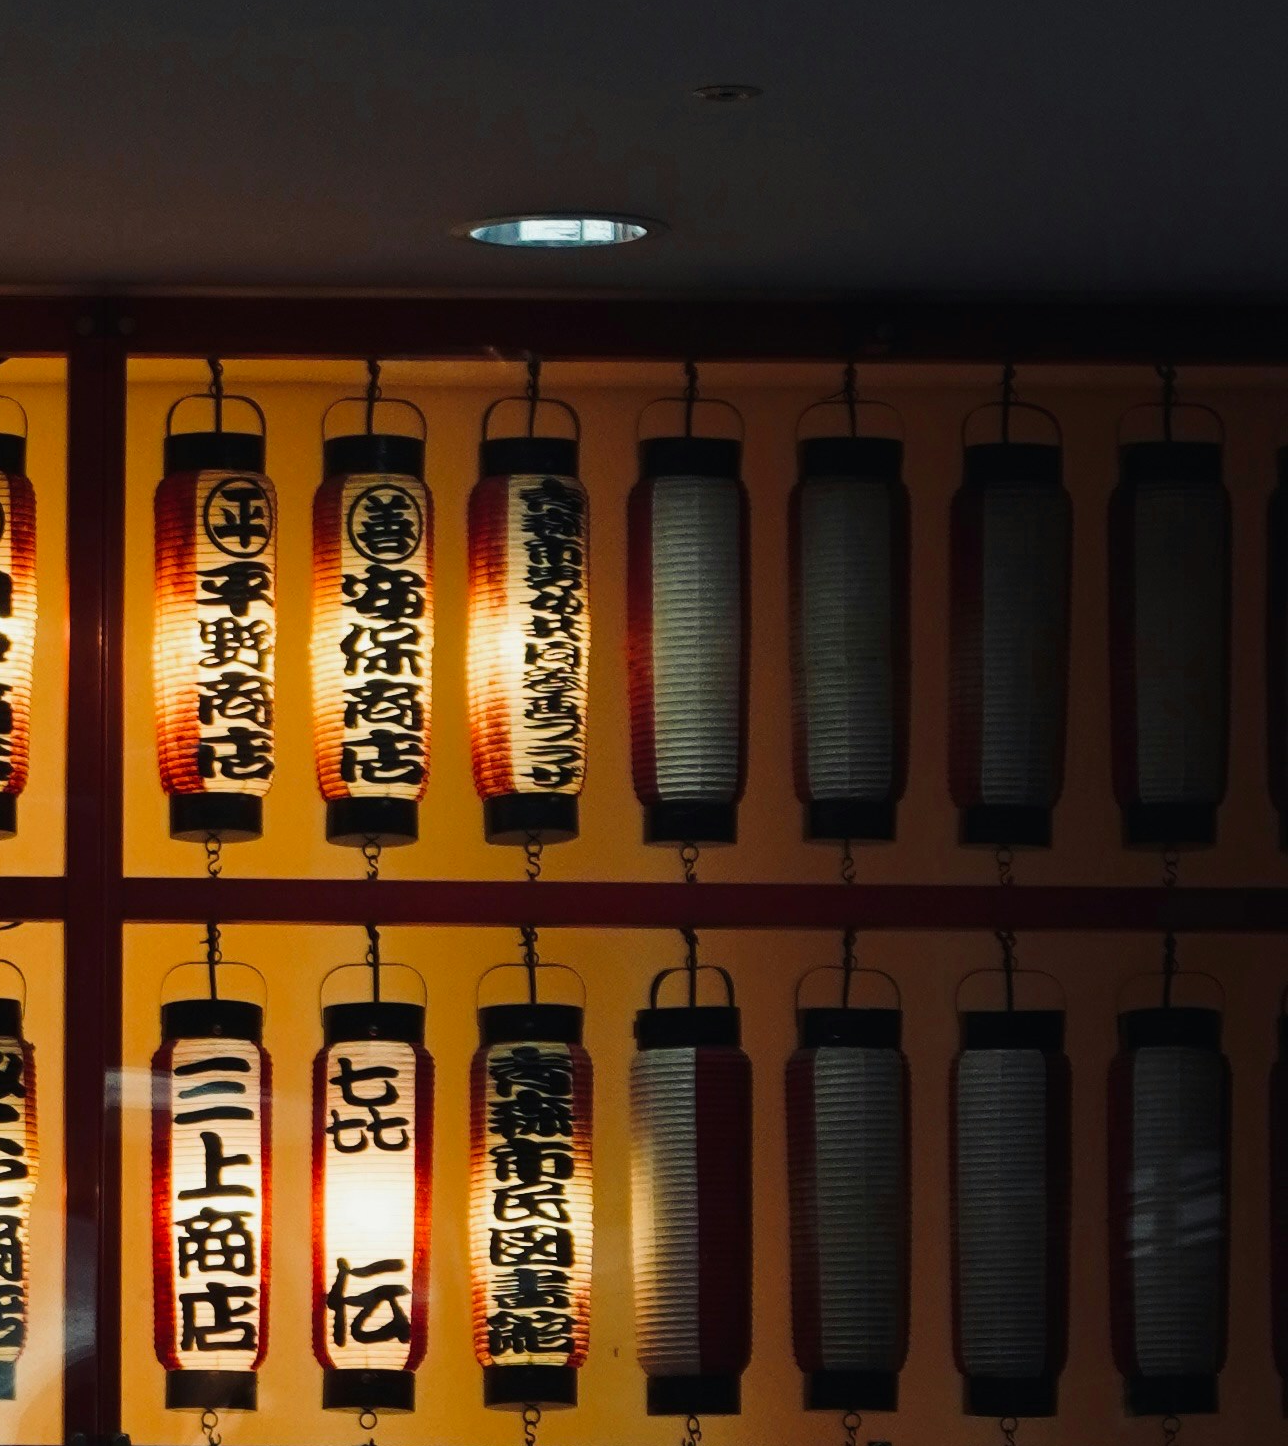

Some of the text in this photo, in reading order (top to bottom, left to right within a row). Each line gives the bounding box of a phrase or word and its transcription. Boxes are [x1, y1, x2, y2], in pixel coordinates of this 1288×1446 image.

[173, 1056, 257, 1352] 三上商店
[487, 1046, 576, 1354] 青森市民図書館
